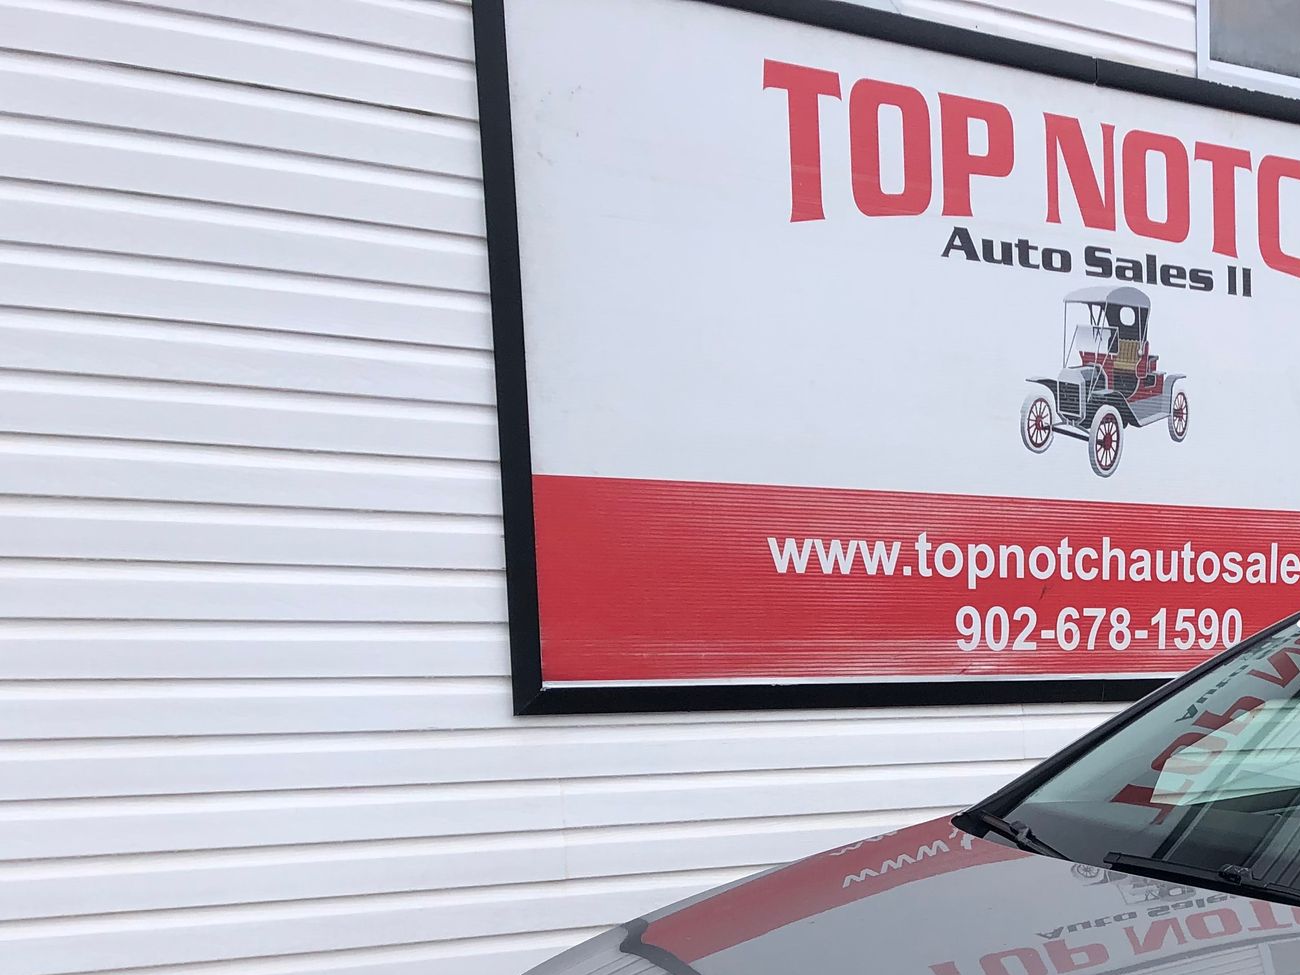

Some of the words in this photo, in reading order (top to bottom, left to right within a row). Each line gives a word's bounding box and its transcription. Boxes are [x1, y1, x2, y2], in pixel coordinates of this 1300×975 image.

[763, 59, 1015, 223] TOP
[941, 226, 1072, 274] Auto
[1084, 245, 1214, 292] Sales
[1227, 265, 1252, 297] II
[955, 604, 1242, 652] 902-678-1590
